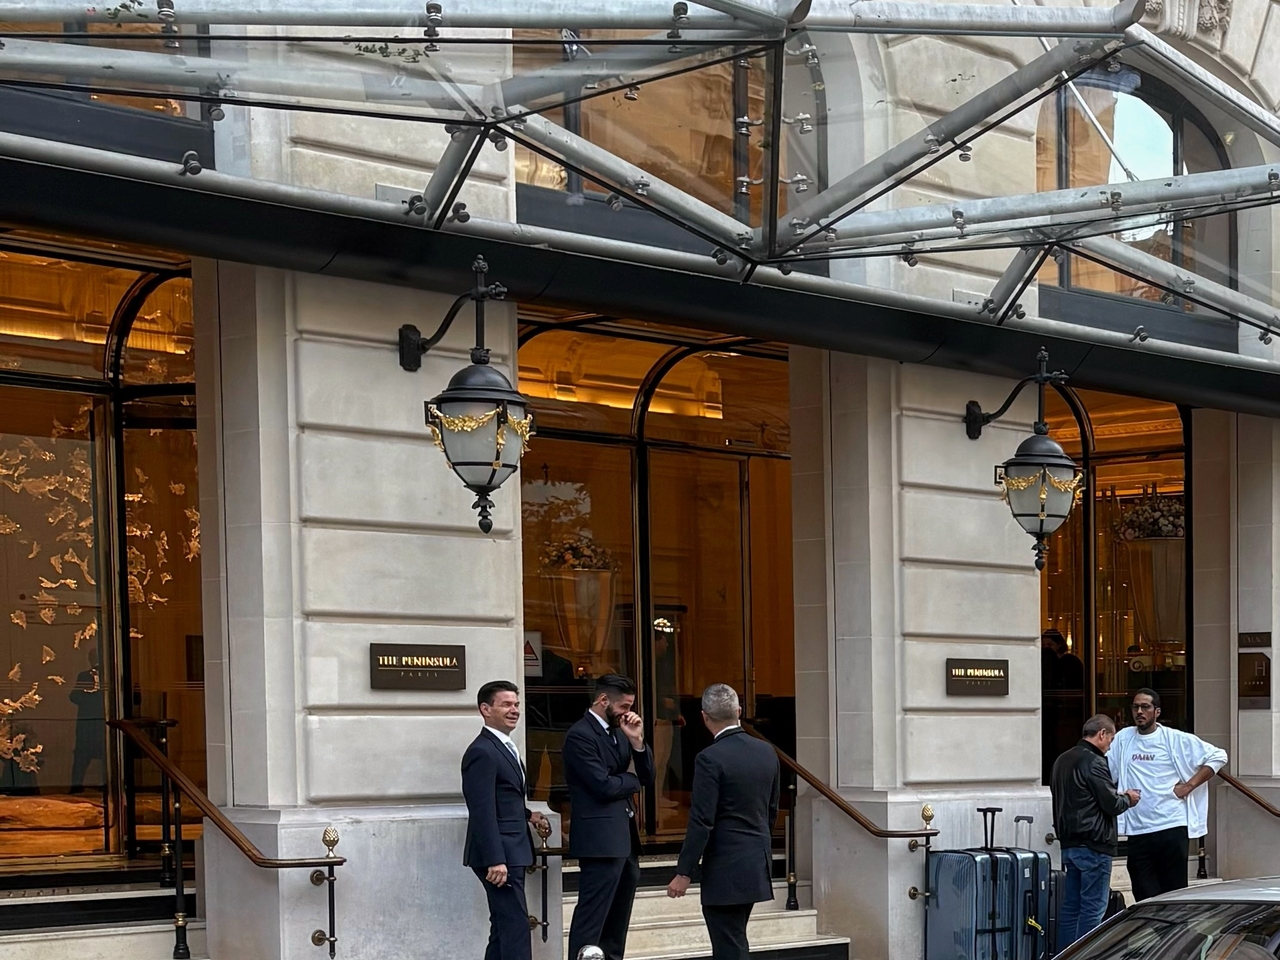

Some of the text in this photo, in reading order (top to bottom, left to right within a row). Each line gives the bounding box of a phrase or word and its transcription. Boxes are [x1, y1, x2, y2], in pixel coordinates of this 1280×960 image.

[377, 655, 458, 667] THE PENINSULA
[1254, 661, 1266, 676] H
